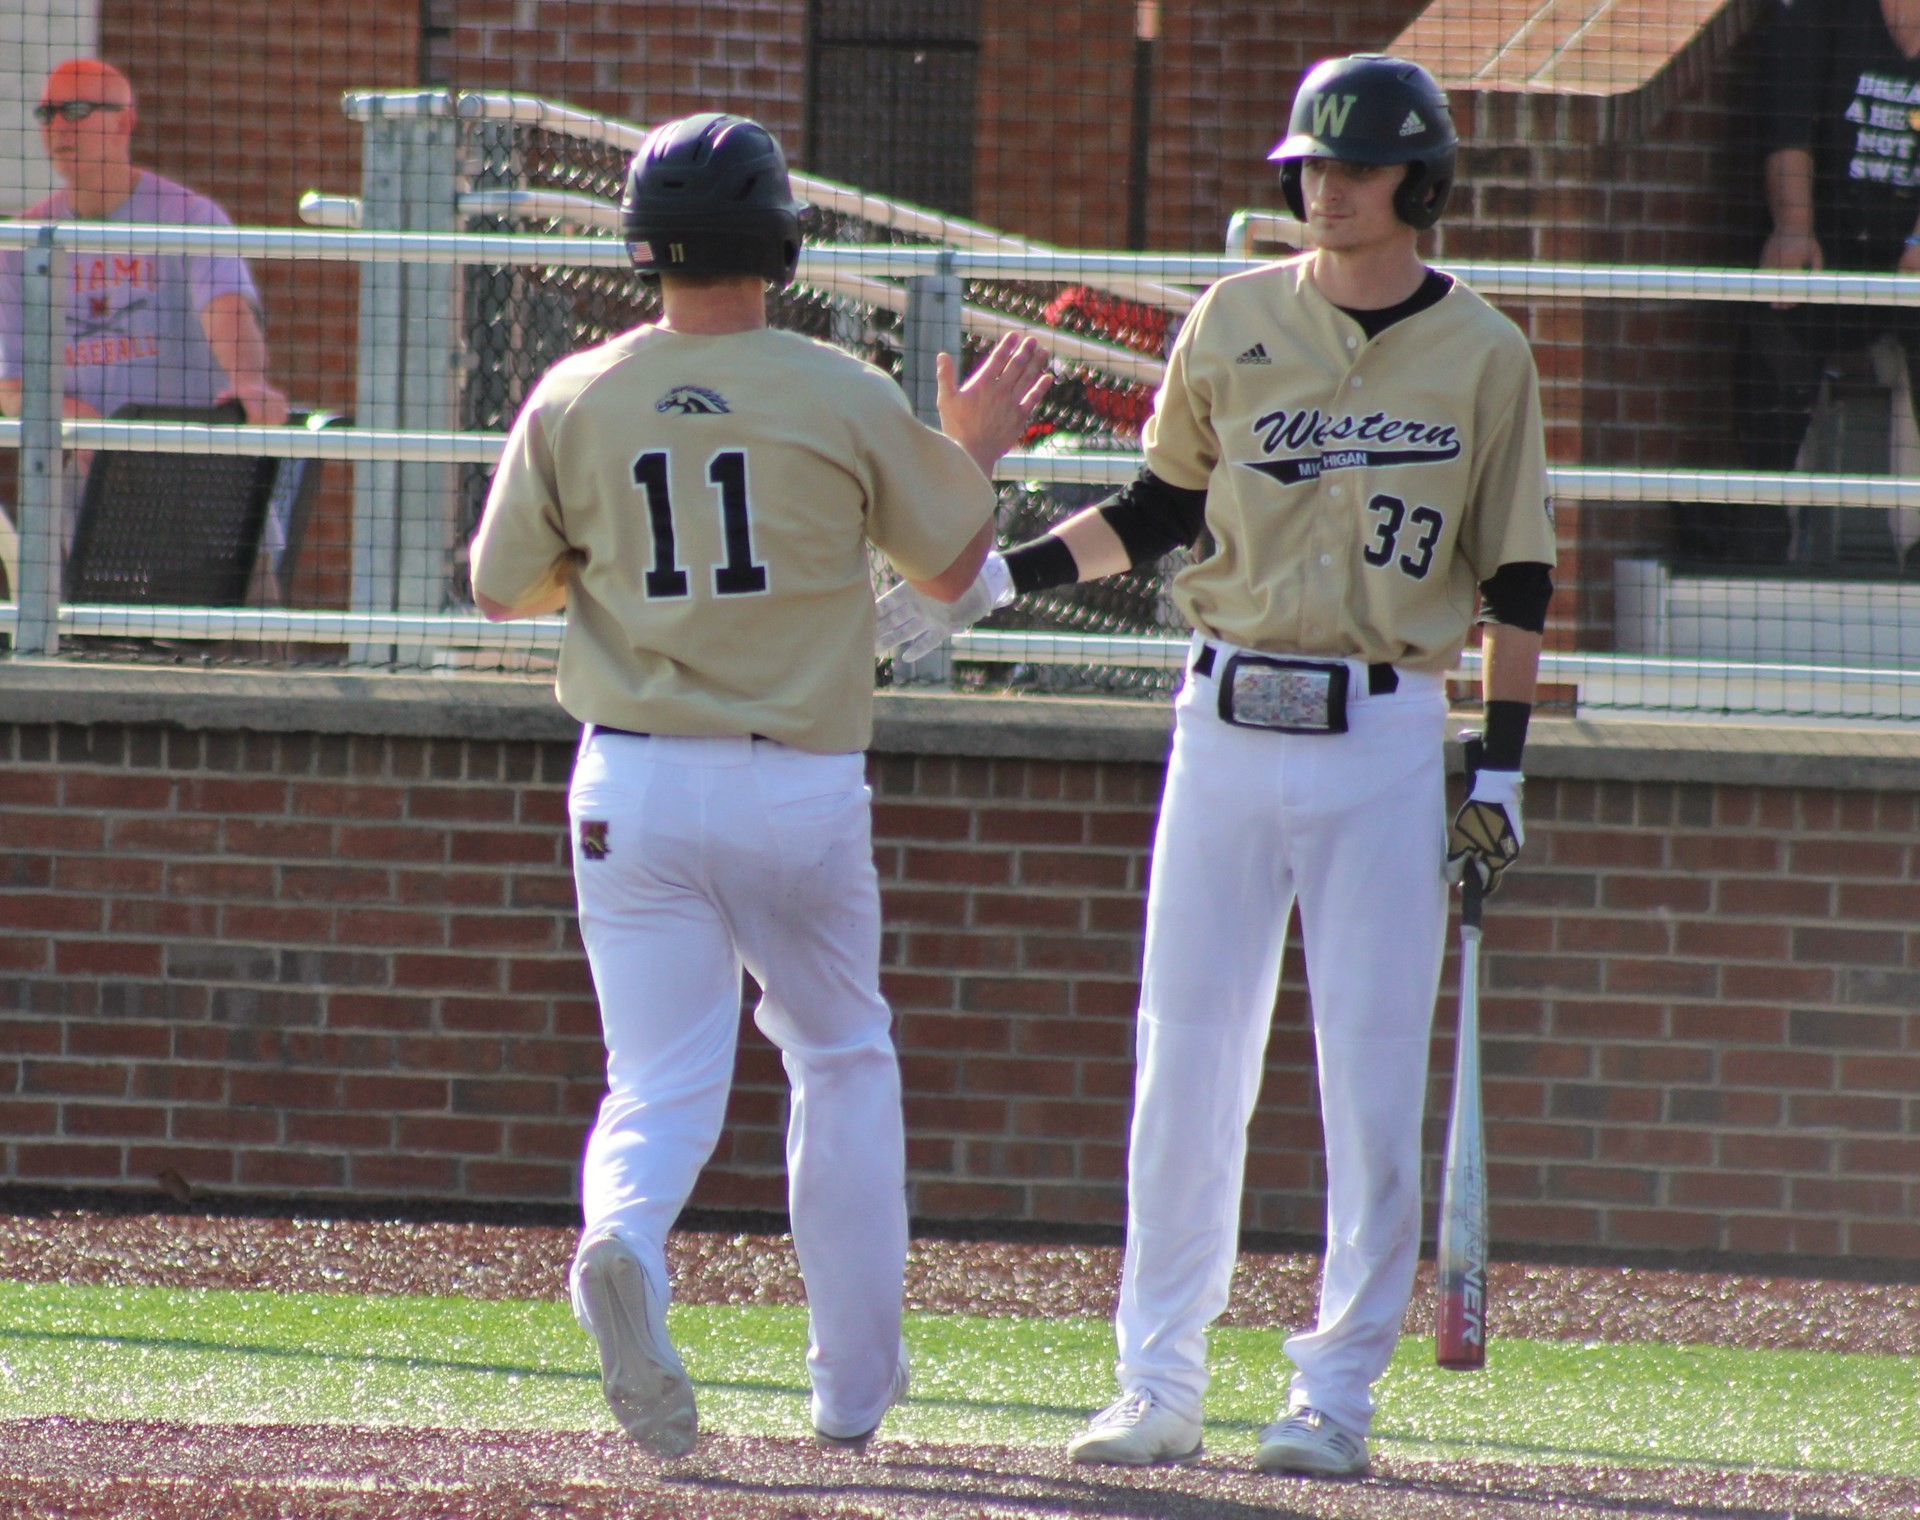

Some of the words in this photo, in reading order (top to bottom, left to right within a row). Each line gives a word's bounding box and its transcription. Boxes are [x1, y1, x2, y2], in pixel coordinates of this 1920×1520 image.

[1313, 93, 1358, 138] W
[1855, 129, 1914, 158] NOT
[669, 243, 684, 263] 11
[72, 256, 156, 293] IAMI
[64, 334, 160, 367] ASEBALL
[1235, 354, 1272, 366] adidas
[1252, 407, 1462, 456] Western
[629, 447, 769, 602] 11
[1362, 493, 1443, 580] 33
